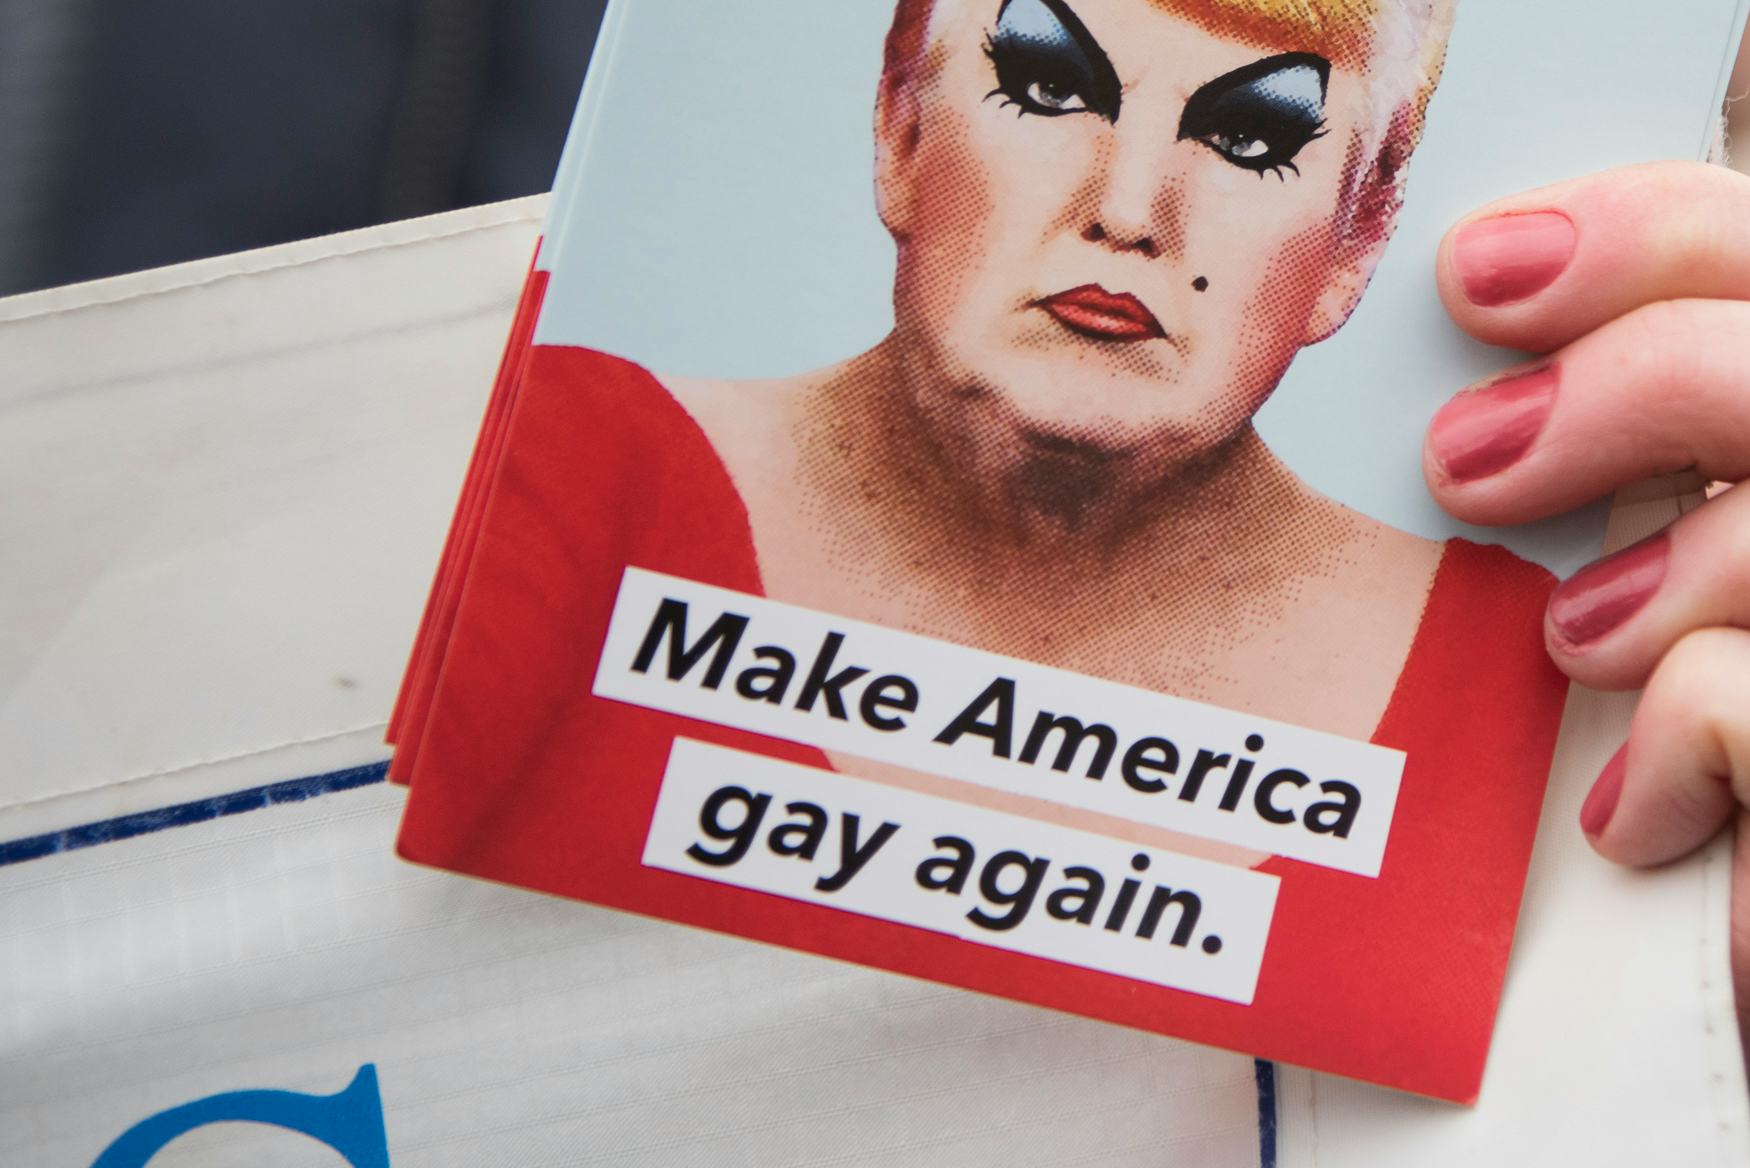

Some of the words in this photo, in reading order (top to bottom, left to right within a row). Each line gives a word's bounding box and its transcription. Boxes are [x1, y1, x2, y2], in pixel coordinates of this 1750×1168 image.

[630, 597, 919, 732] Make
[933, 677, 1362, 839] America
[686, 782, 900, 893] gay
[914, 835, 1223, 955] again.
